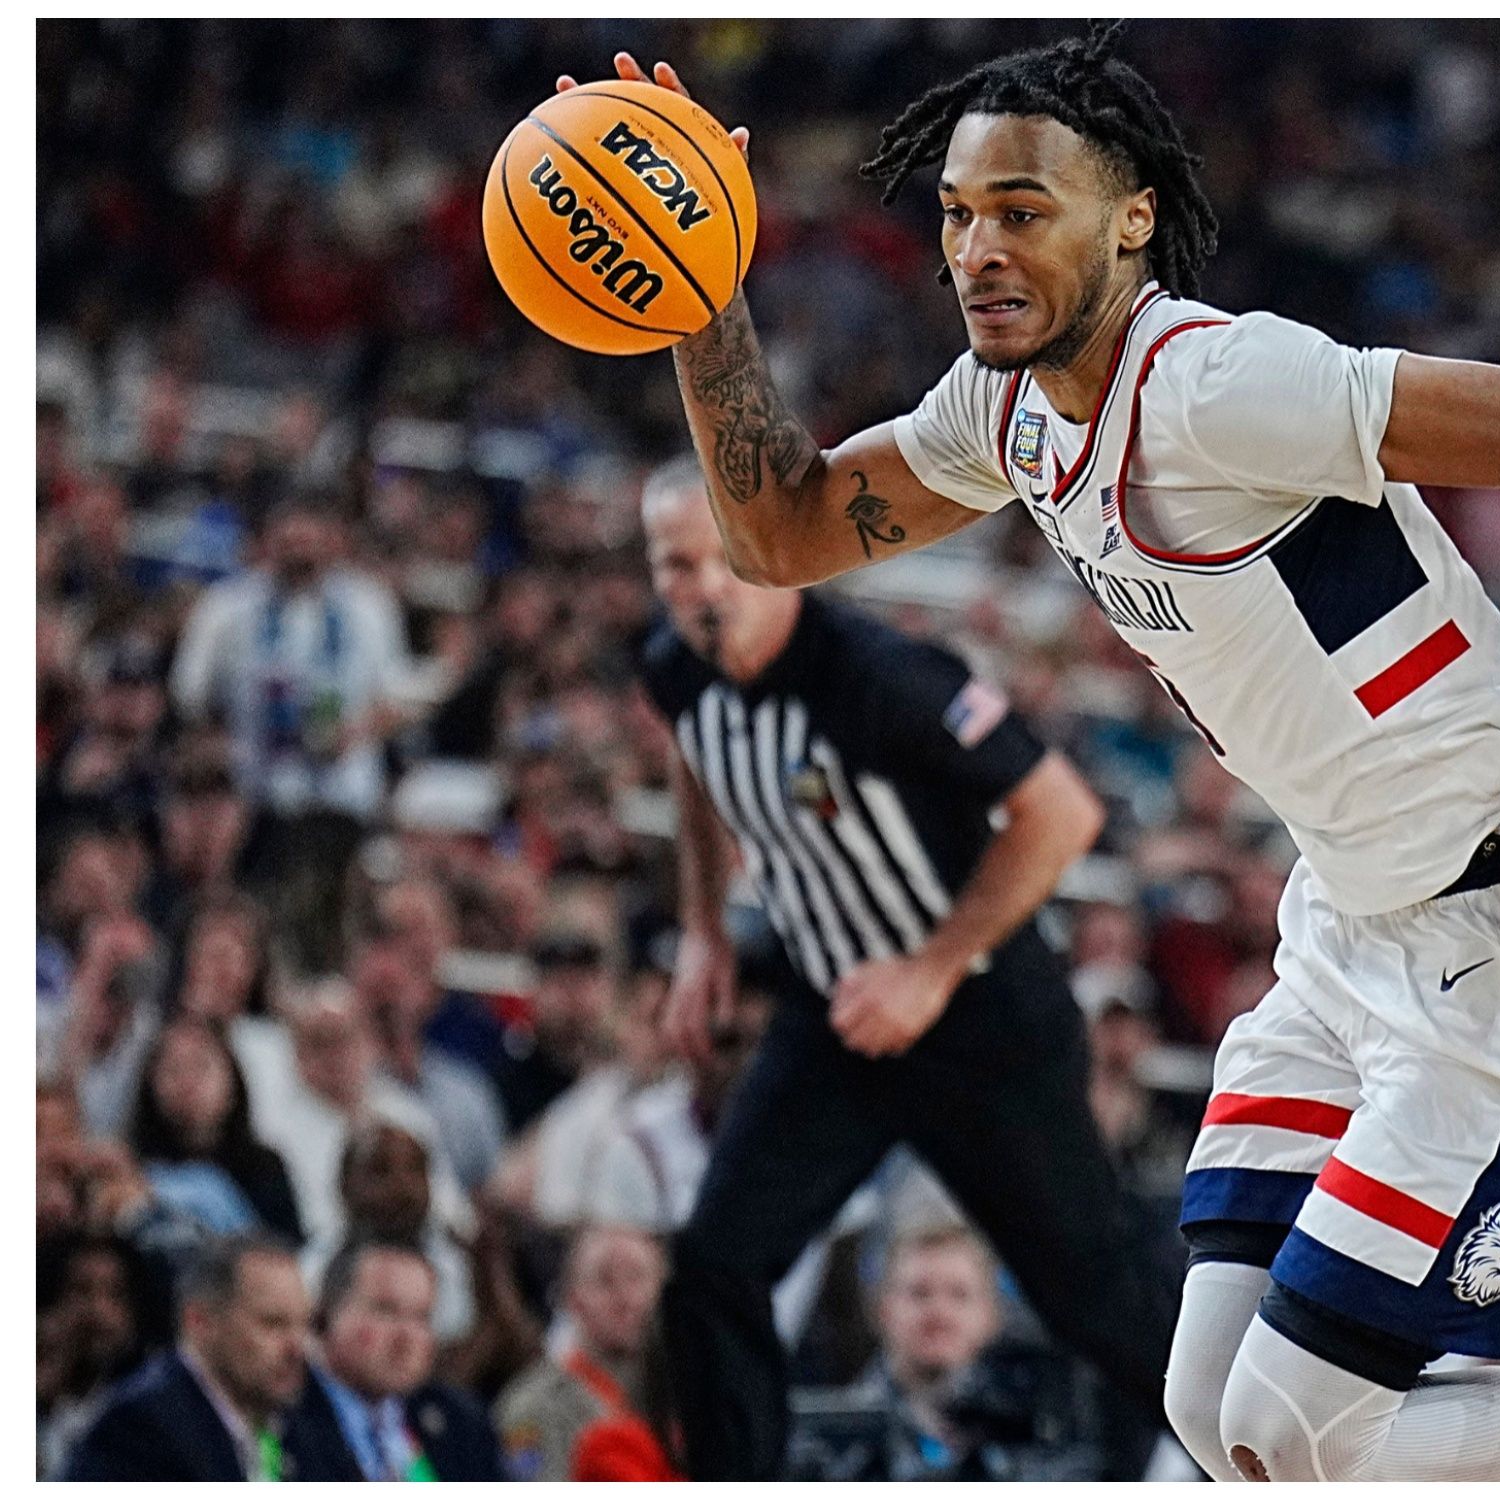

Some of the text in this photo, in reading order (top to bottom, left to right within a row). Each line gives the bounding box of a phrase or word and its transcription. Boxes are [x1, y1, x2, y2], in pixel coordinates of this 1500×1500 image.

[598, 120, 712, 234] NCAA
[528, 153, 665, 315] Wilson
[585, 195, 630, 240] EVO NXT
[1016, 437, 1039, 453] FOUR
[1018, 422, 1041, 438] FINAL
